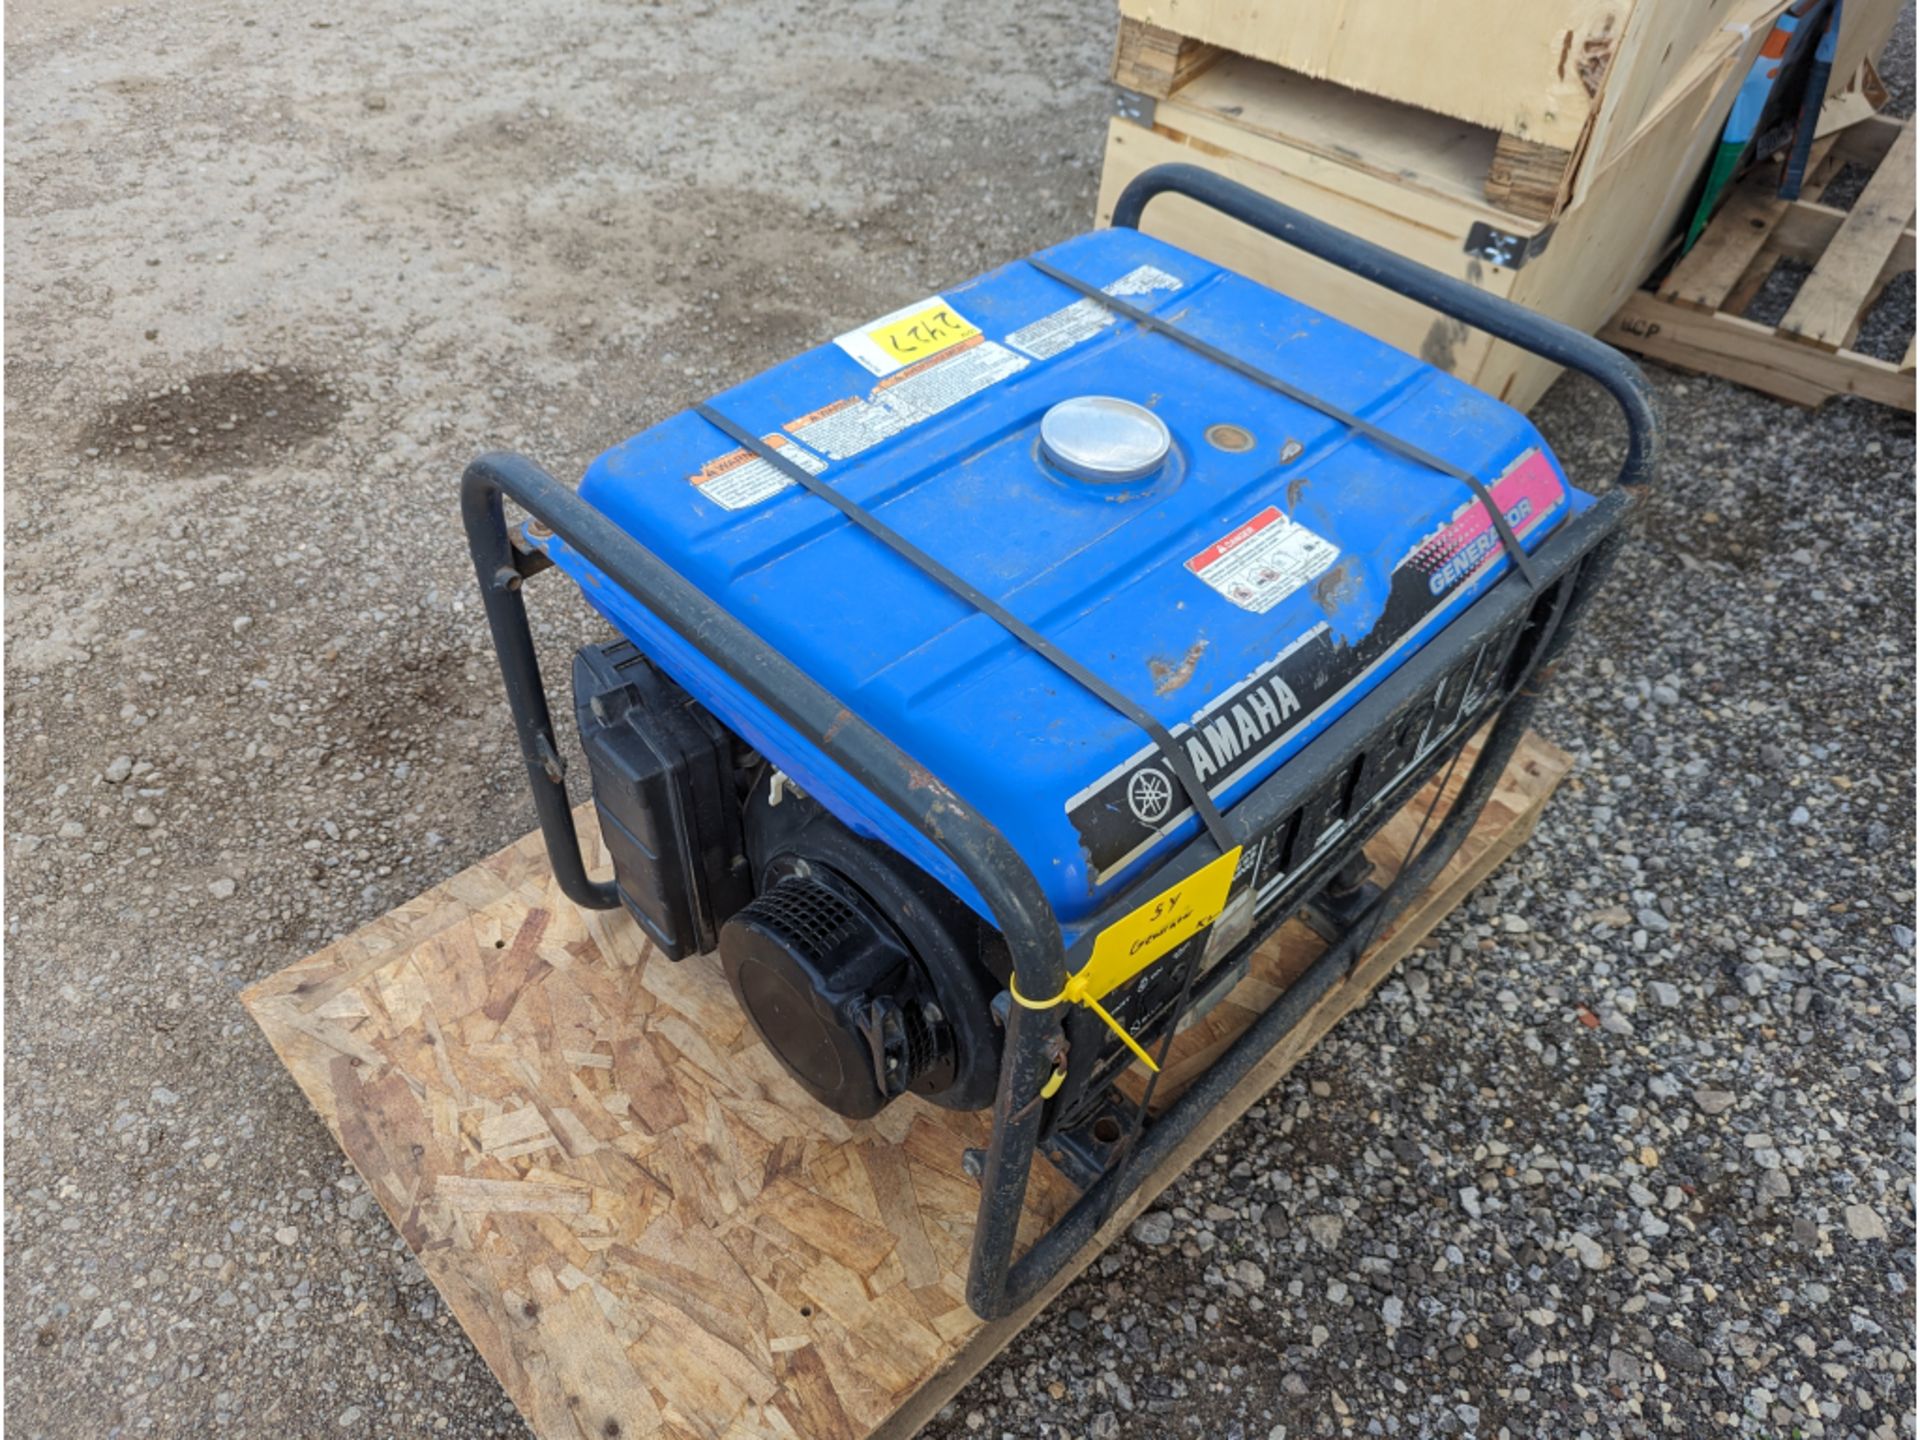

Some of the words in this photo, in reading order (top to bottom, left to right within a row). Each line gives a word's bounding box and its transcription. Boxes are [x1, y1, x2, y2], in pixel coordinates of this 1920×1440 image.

[890, 311, 961, 352] 2427
[1428, 497, 1532, 597] GENERAOR
[1161, 675, 1301, 783] AMAHA
